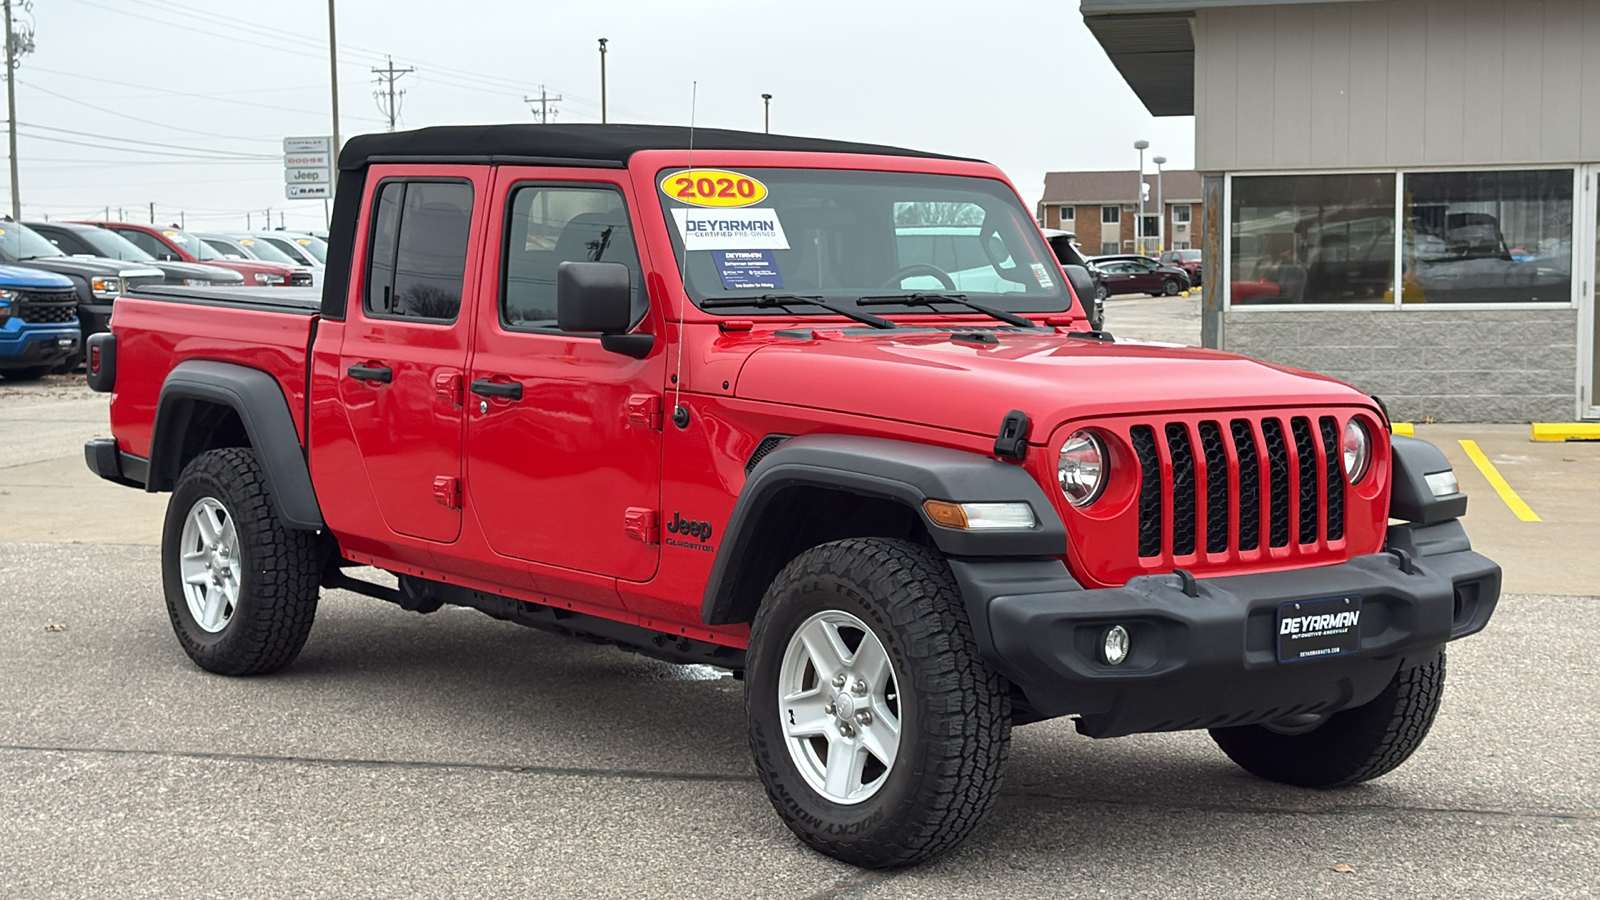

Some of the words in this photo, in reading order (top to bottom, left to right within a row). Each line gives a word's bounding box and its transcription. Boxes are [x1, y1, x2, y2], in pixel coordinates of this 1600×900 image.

[294, 170, 319, 181] Jeep
[675, 177, 756, 199] 2020
[686, 220, 774, 232] DEYARMAN
[666, 511, 713, 543] Jeep
[665, 538, 715, 553] GLADIATOR
[1280, 611, 1360, 635] DEYARMAN
